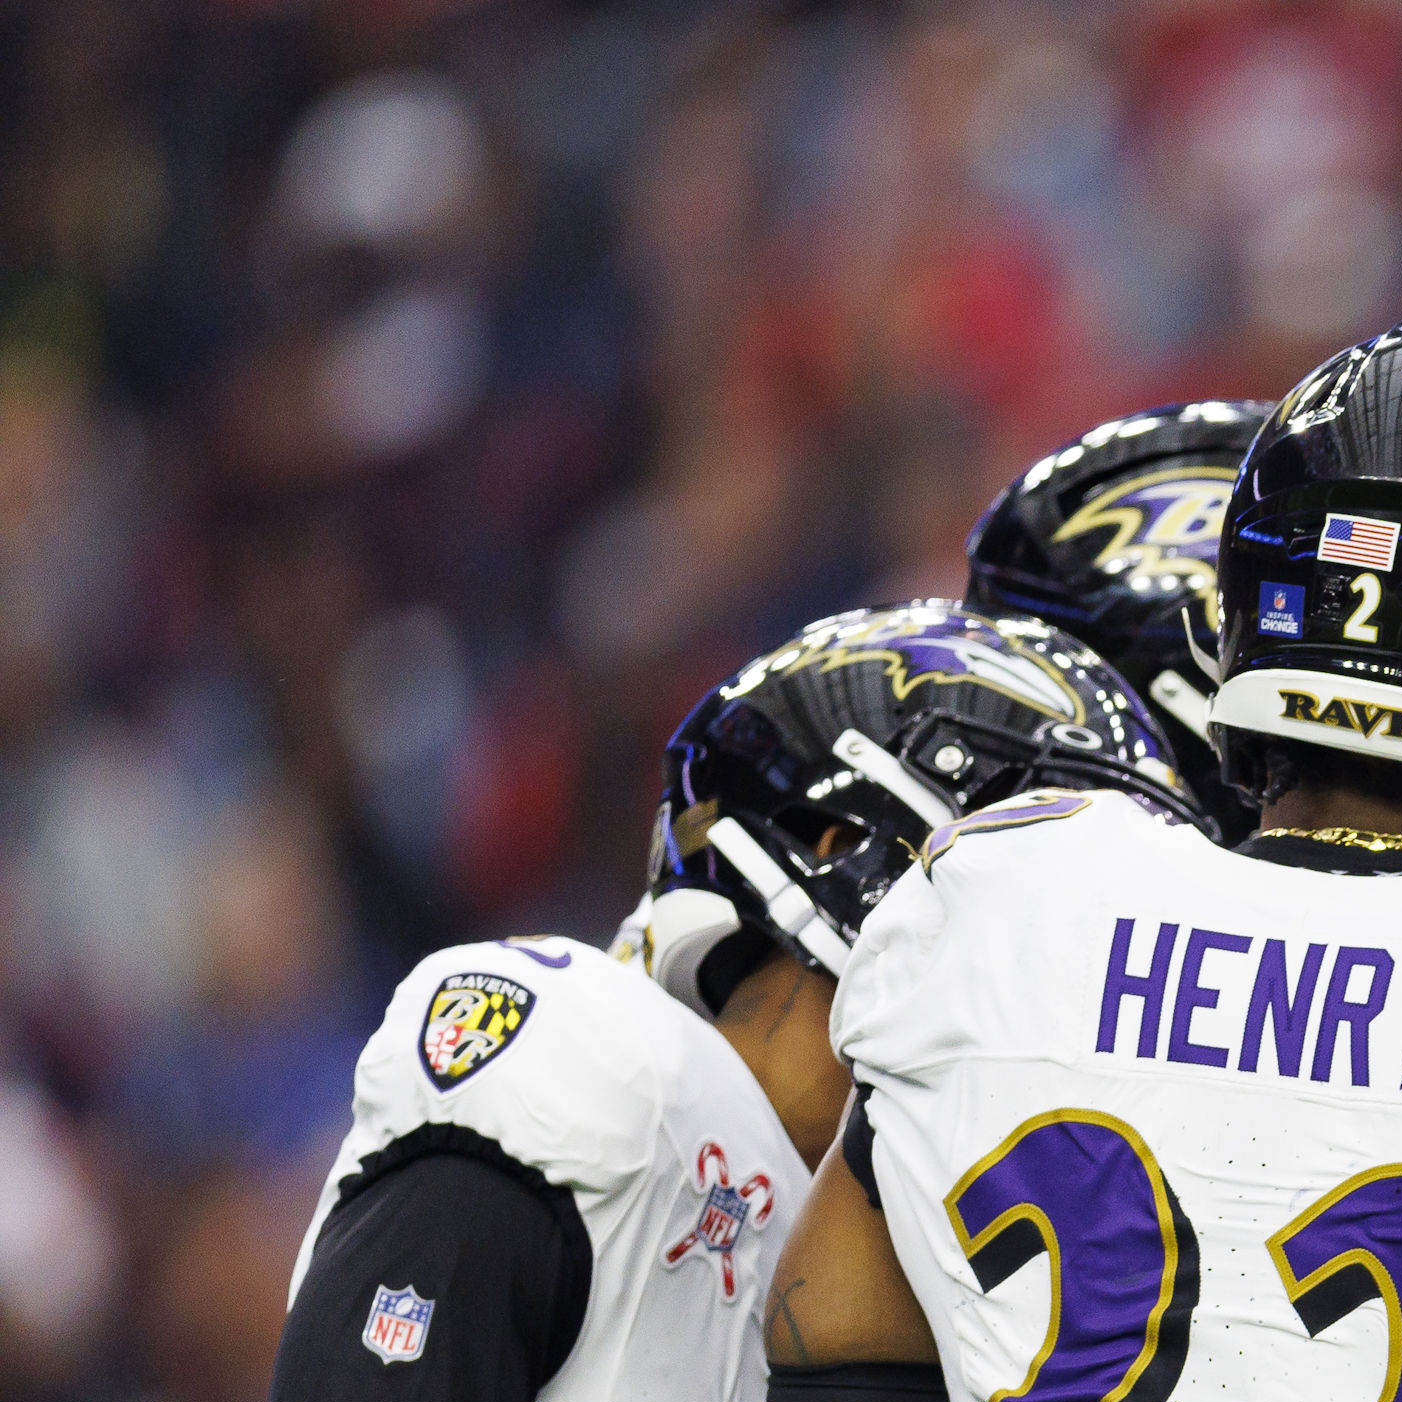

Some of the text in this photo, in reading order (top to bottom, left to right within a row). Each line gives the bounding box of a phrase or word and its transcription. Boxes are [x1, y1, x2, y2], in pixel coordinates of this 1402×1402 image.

[1260, 618, 1299, 635] CHANGE
[1343, 572, 1382, 643] 2
[446, 975, 529, 1006] RAVENS
[702, 1206, 736, 1247] NFL
[371, 1314, 417, 1353] NFL
